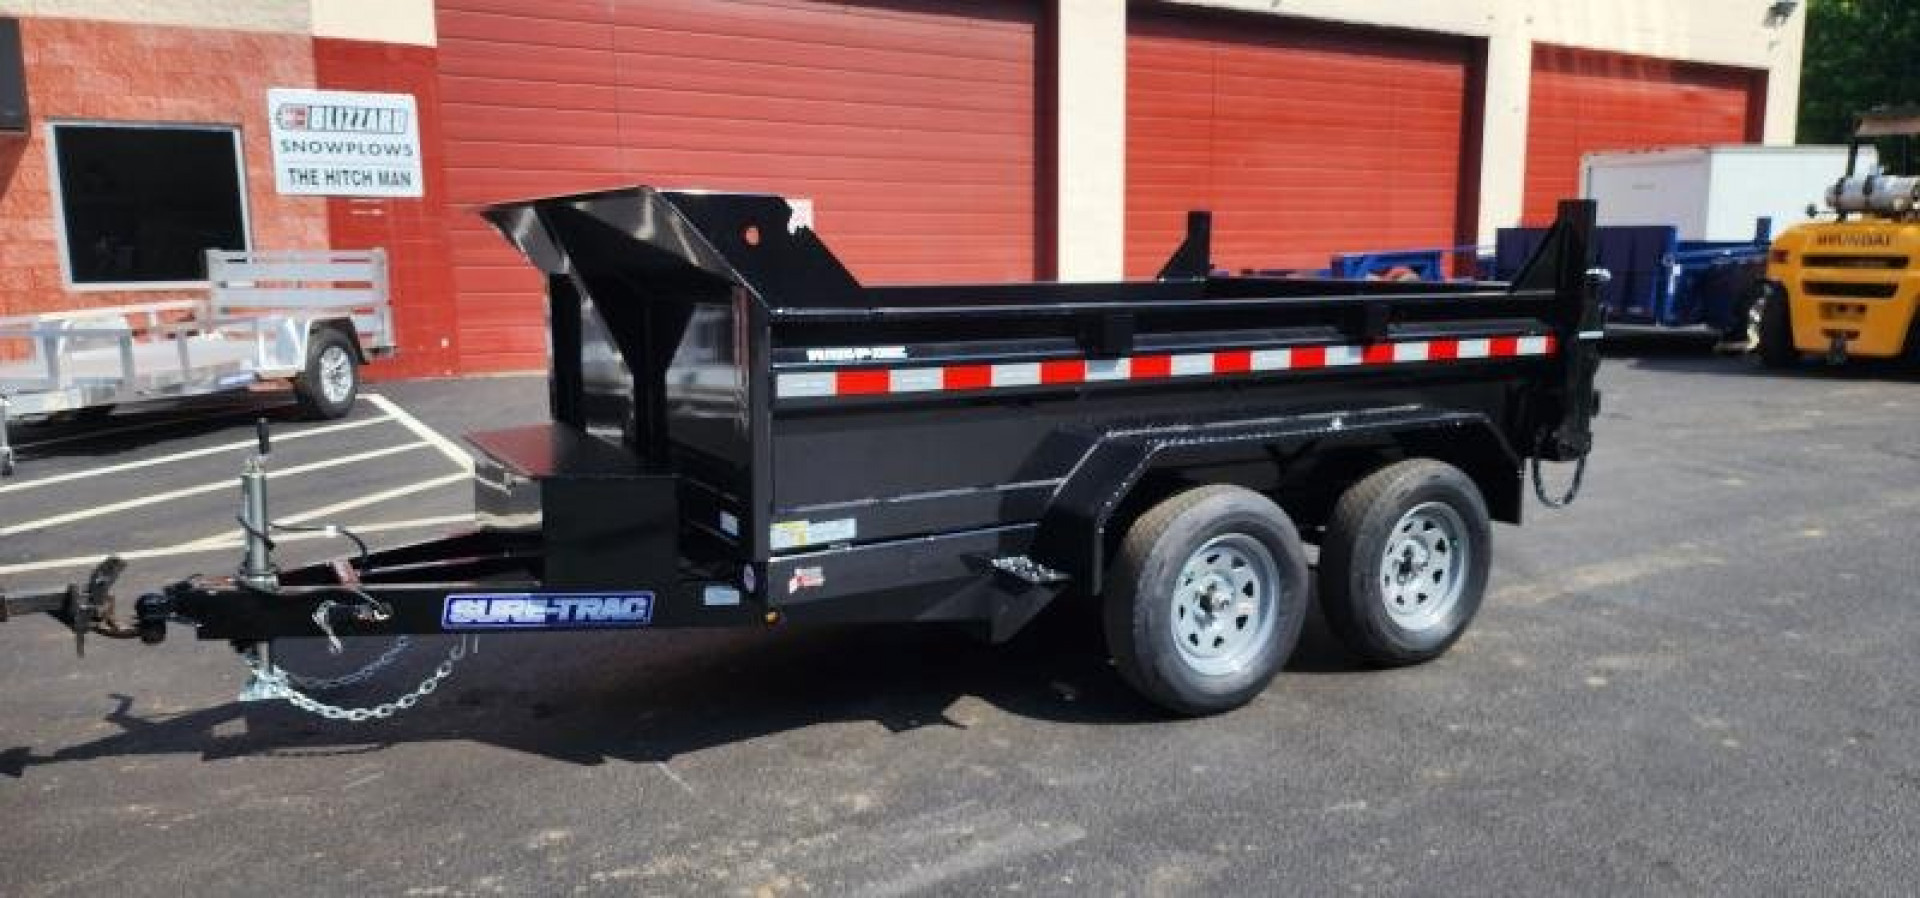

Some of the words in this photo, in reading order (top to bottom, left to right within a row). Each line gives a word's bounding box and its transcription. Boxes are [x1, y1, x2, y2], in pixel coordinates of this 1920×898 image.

[307, 105, 409, 134] BLIZZARD
[280, 138, 414, 157] SNOWPLOWS
[287, 167, 320, 186] THE
[324, 167, 373, 187] HITCH
[378, 171, 412, 187] MAN
[1816, 233, 1890, 247] HYUNDAI
[449, 596, 649, 623] SURE-TRAC
